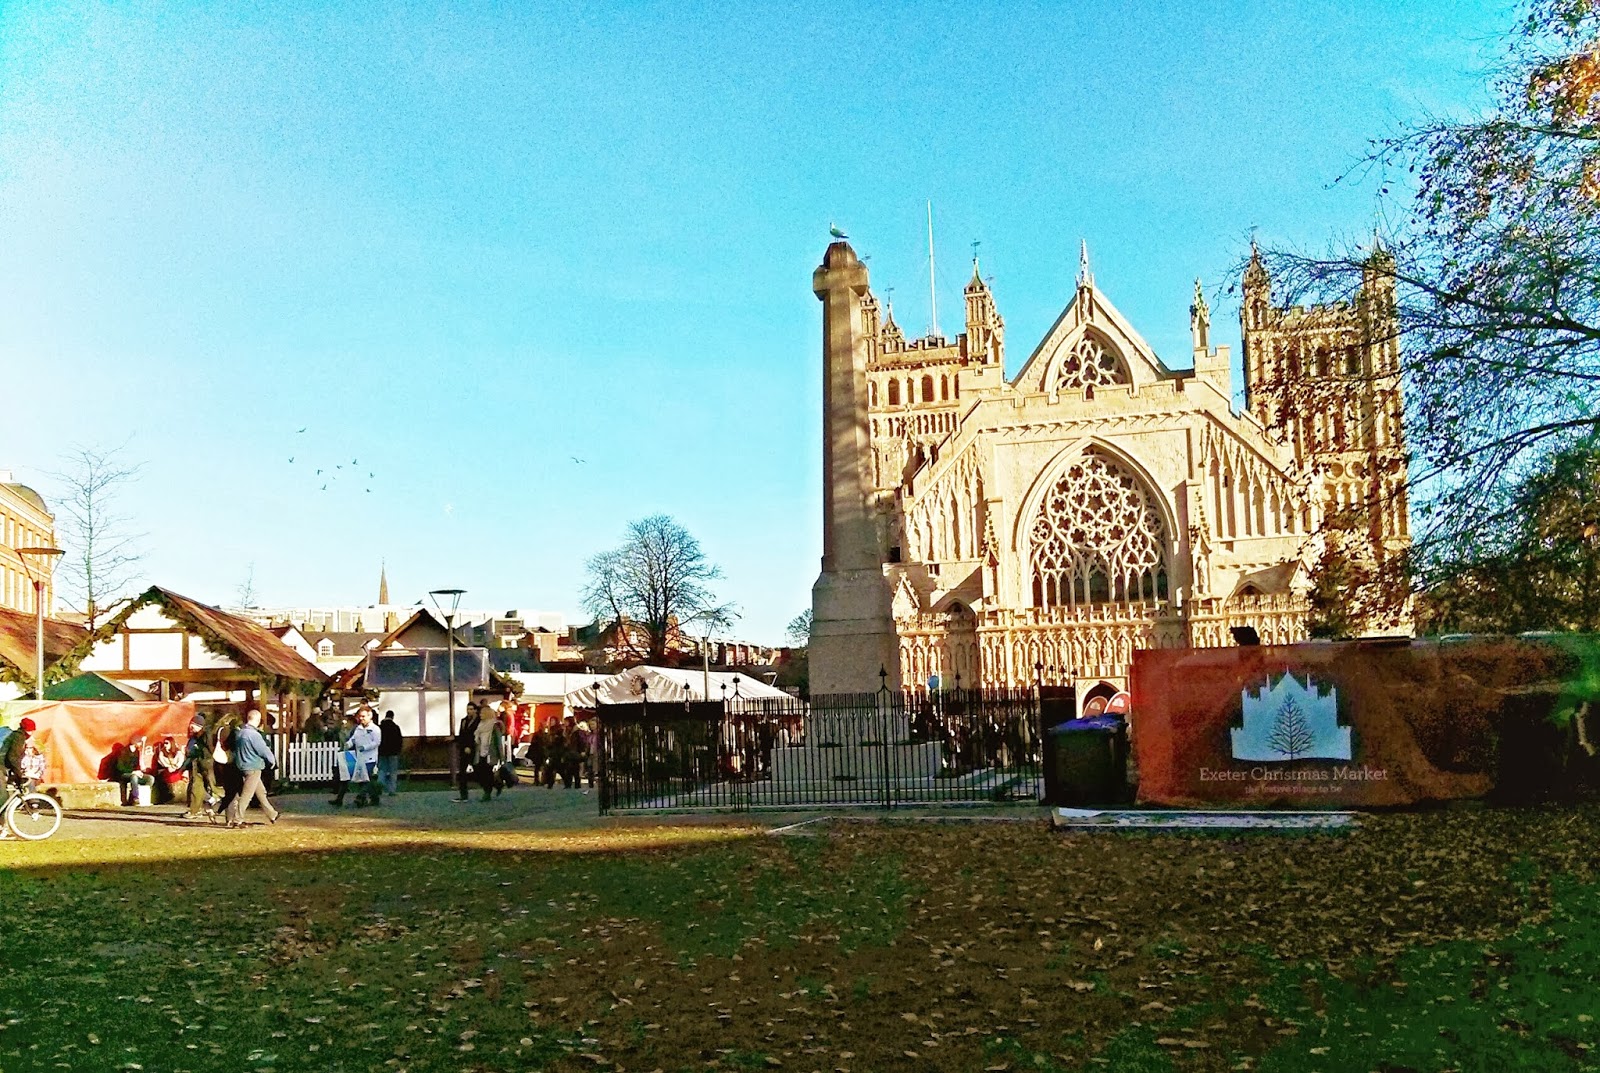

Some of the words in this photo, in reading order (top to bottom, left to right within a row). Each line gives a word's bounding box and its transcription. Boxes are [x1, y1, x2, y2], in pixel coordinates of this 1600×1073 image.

[1199, 767, 1247, 781] Exeter
[1251, 766, 1329, 781] Christmas
[1332, 765, 1388, 781] Market
